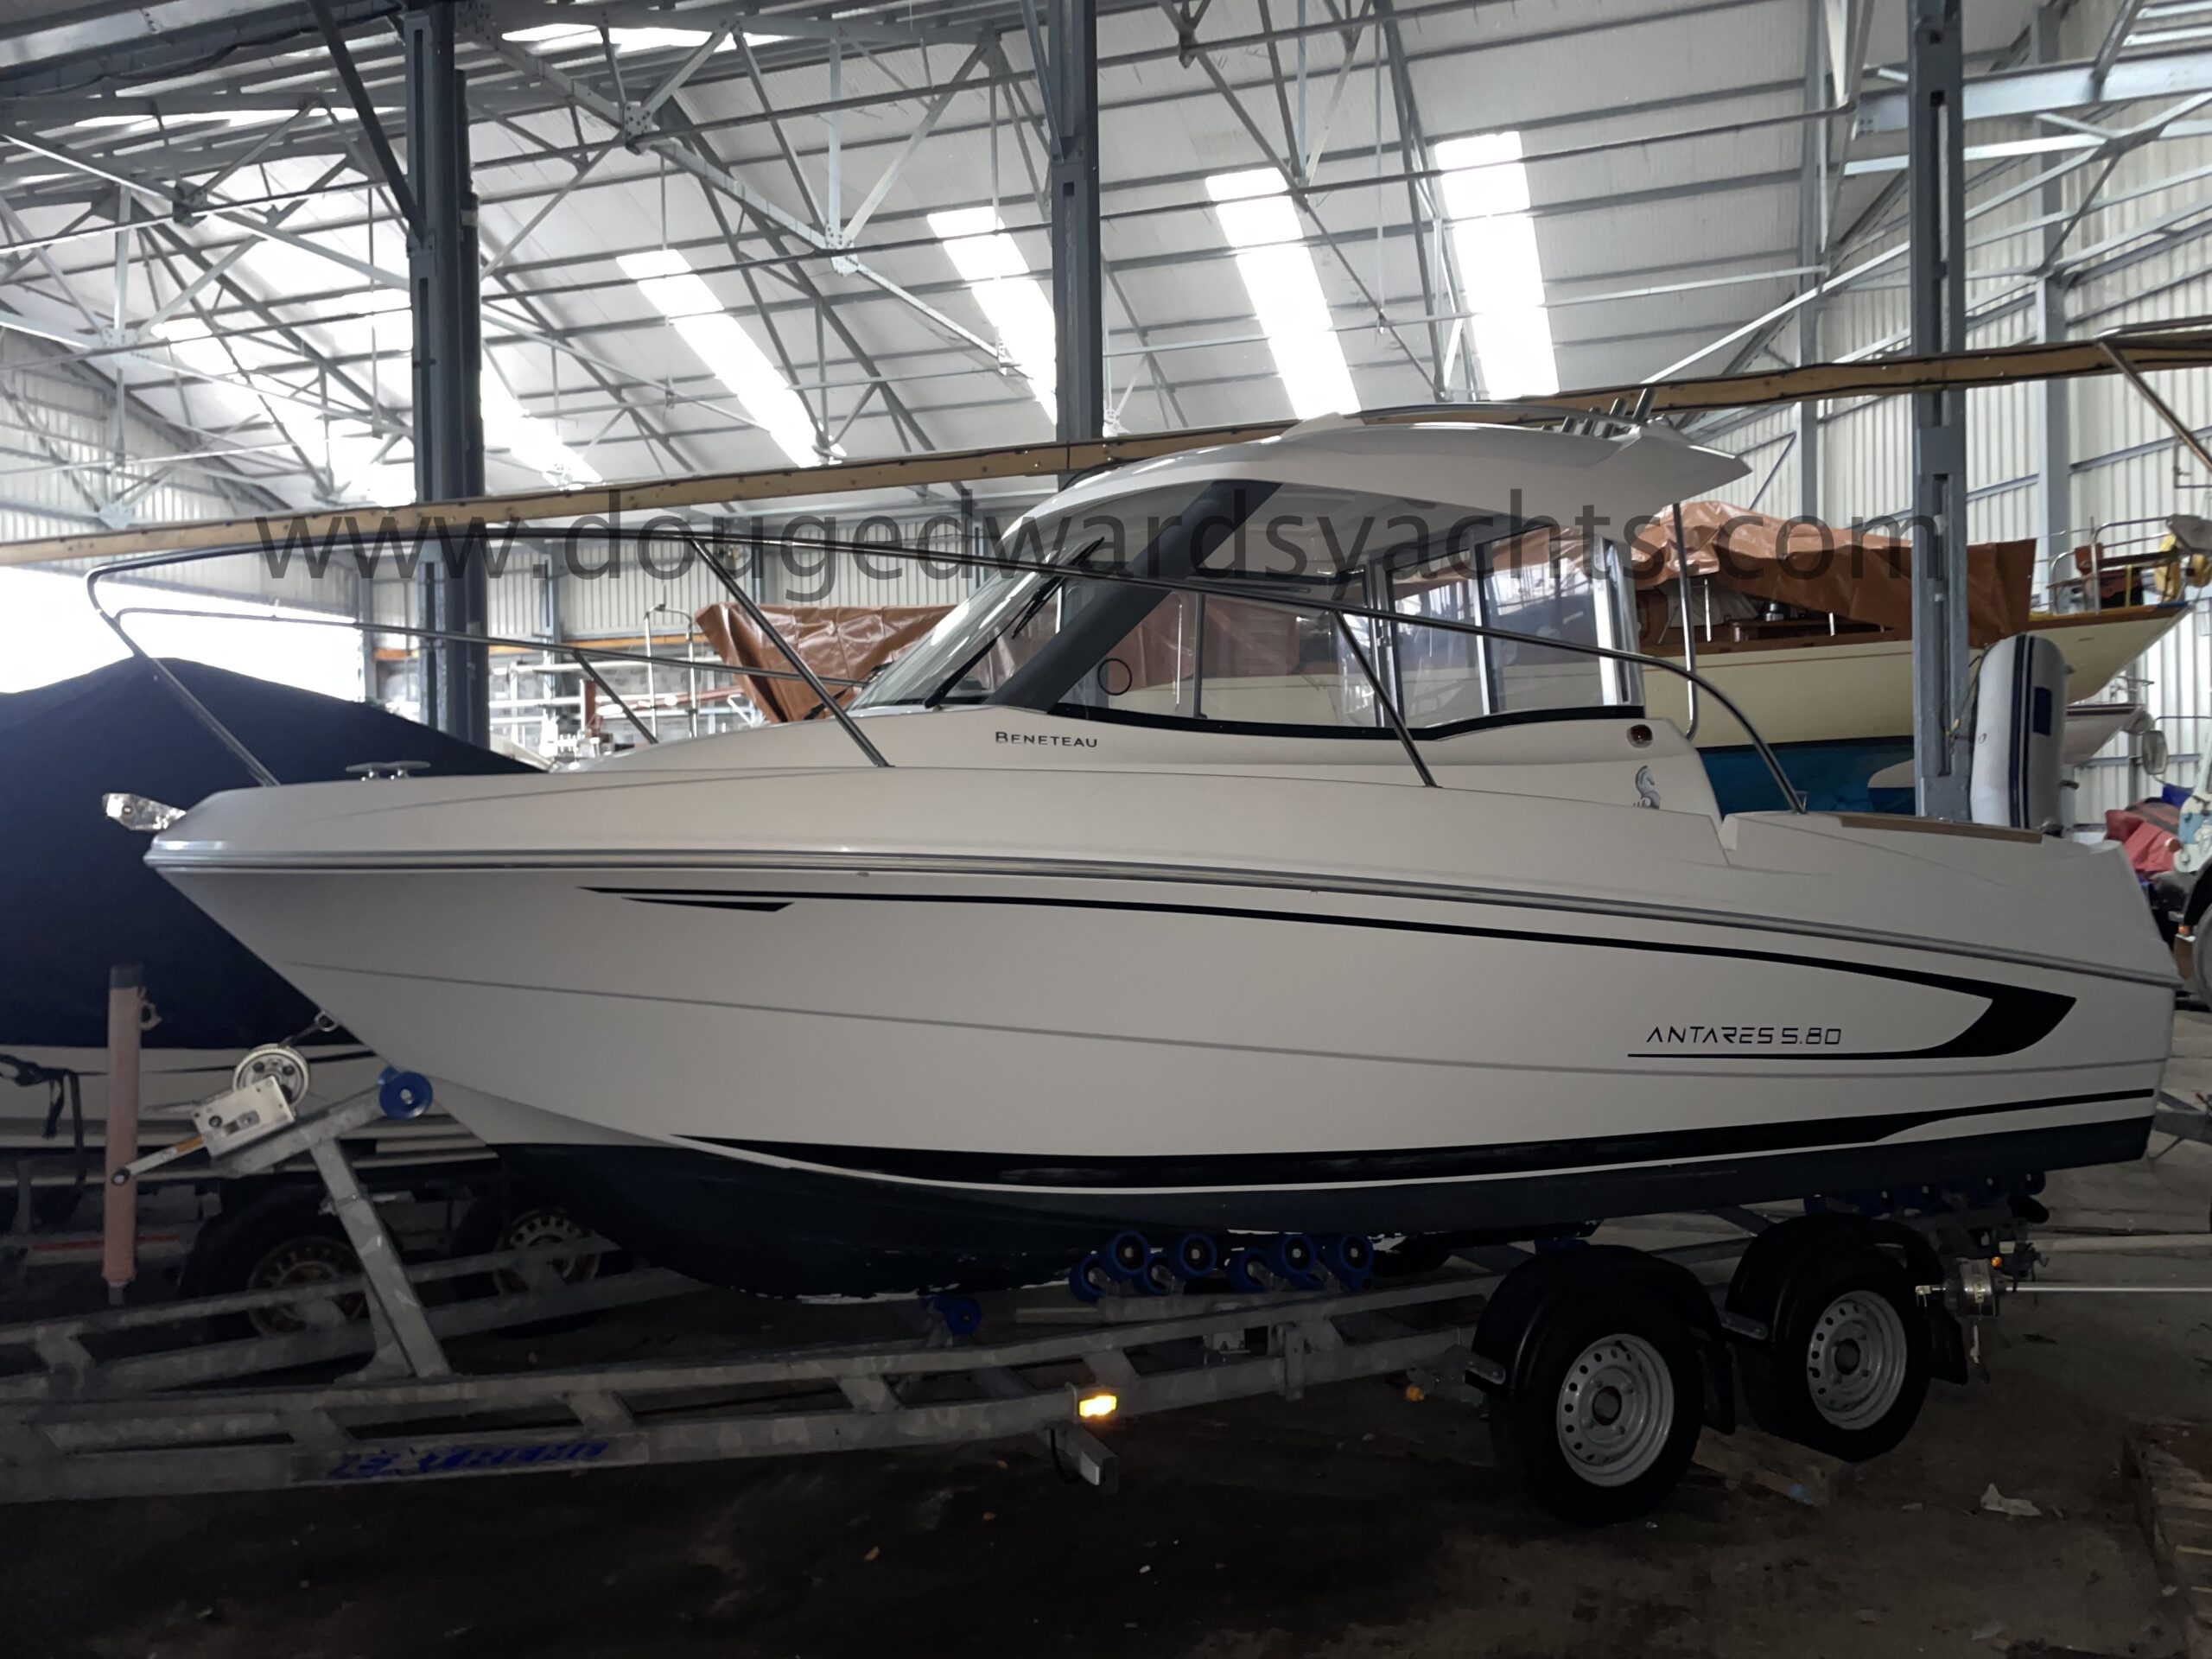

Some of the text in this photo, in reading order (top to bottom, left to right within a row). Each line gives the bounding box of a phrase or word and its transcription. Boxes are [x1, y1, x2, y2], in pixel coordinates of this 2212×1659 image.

[995, 731, 1098, 748] BENETEAU
[1646, 1026, 1841, 1045] ANTARES 5.80
